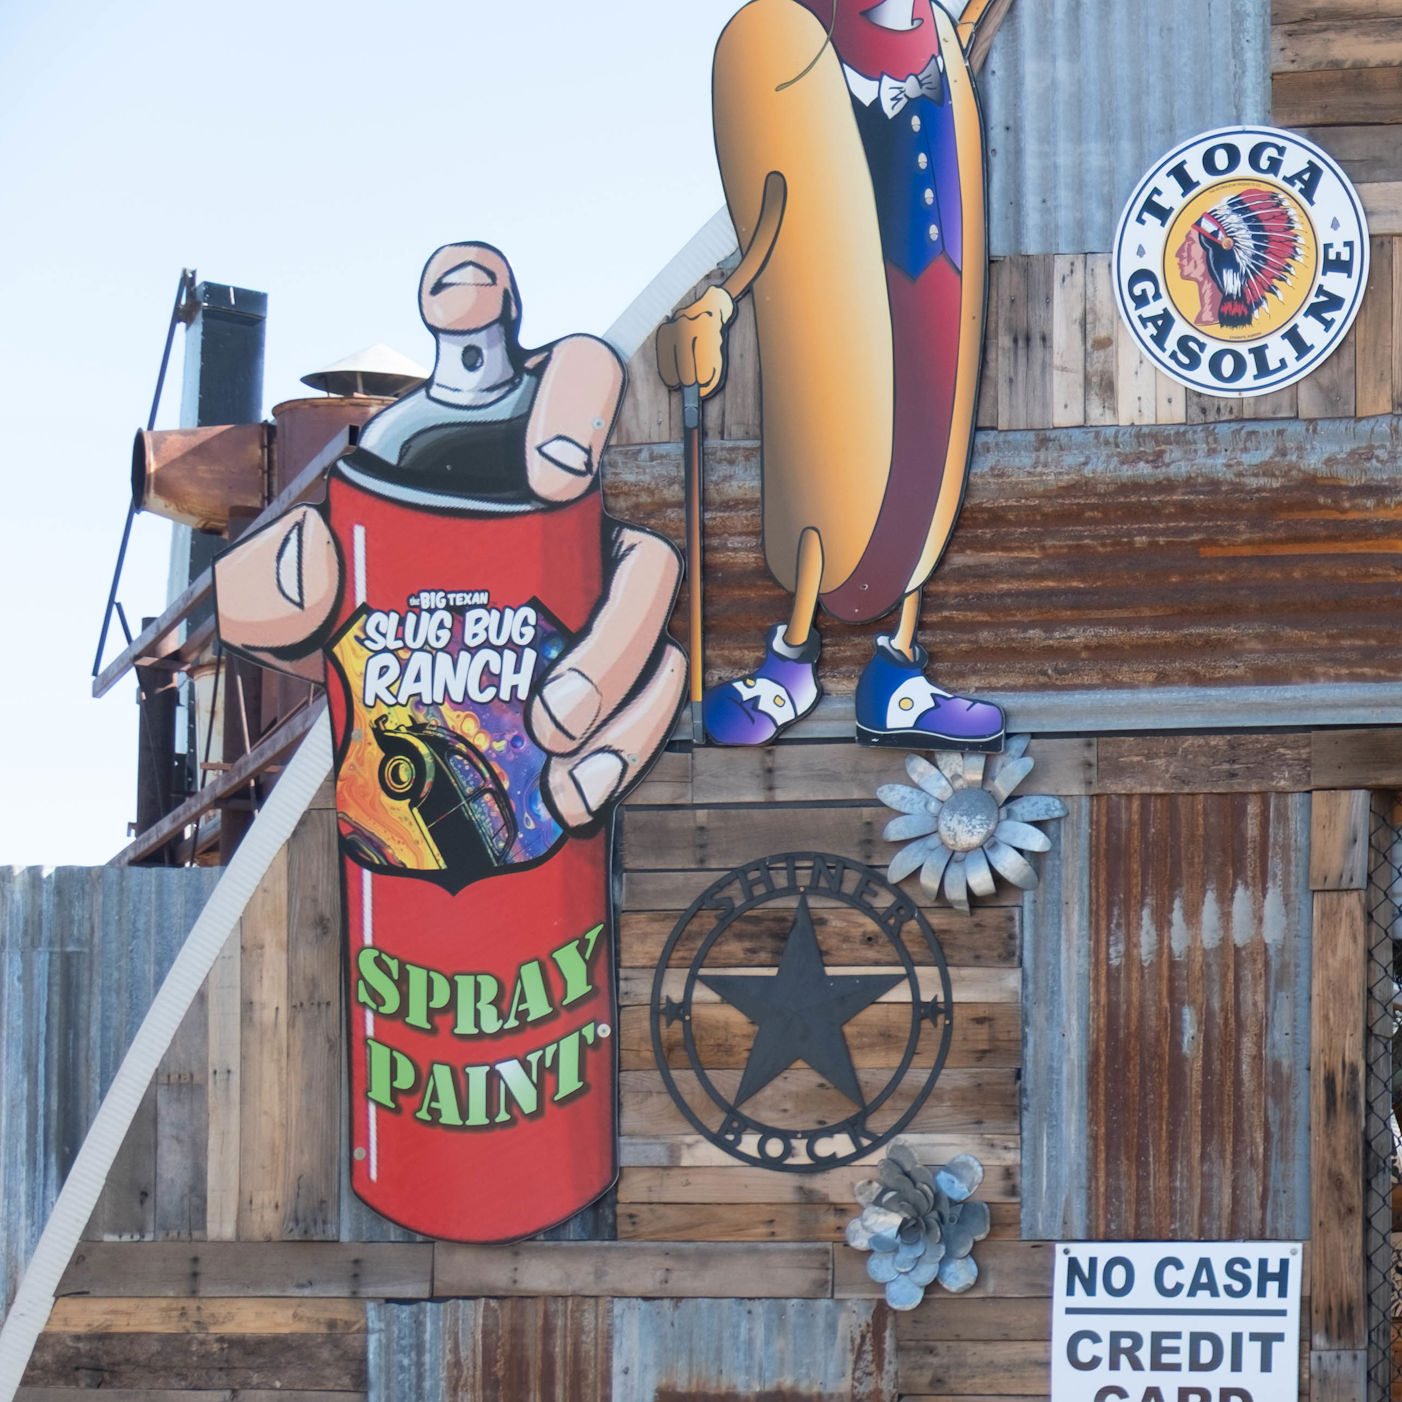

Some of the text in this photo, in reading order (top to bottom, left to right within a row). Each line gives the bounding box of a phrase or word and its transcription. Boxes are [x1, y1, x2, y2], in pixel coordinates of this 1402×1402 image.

[1135, 141, 1324, 228] TIOGA
[1127, 239, 1355, 384] GASOLINE
[363, 606, 537, 651] SLUG BUG
[420, 590, 447, 610] BIG
[447, 591, 489, 607] TEXAN
[363, 648, 538, 708] RANCH
[701, 856, 914, 935] SHINER
[357, 923, 604, 1035] SPRAY
[366, 1021, 596, 1126] PAINT
[714, 1108, 885, 1164] BOCK
[1065, 1255, 1290, 1299] NO CASH
[1066, 1329, 1286, 1373] CREDIT
